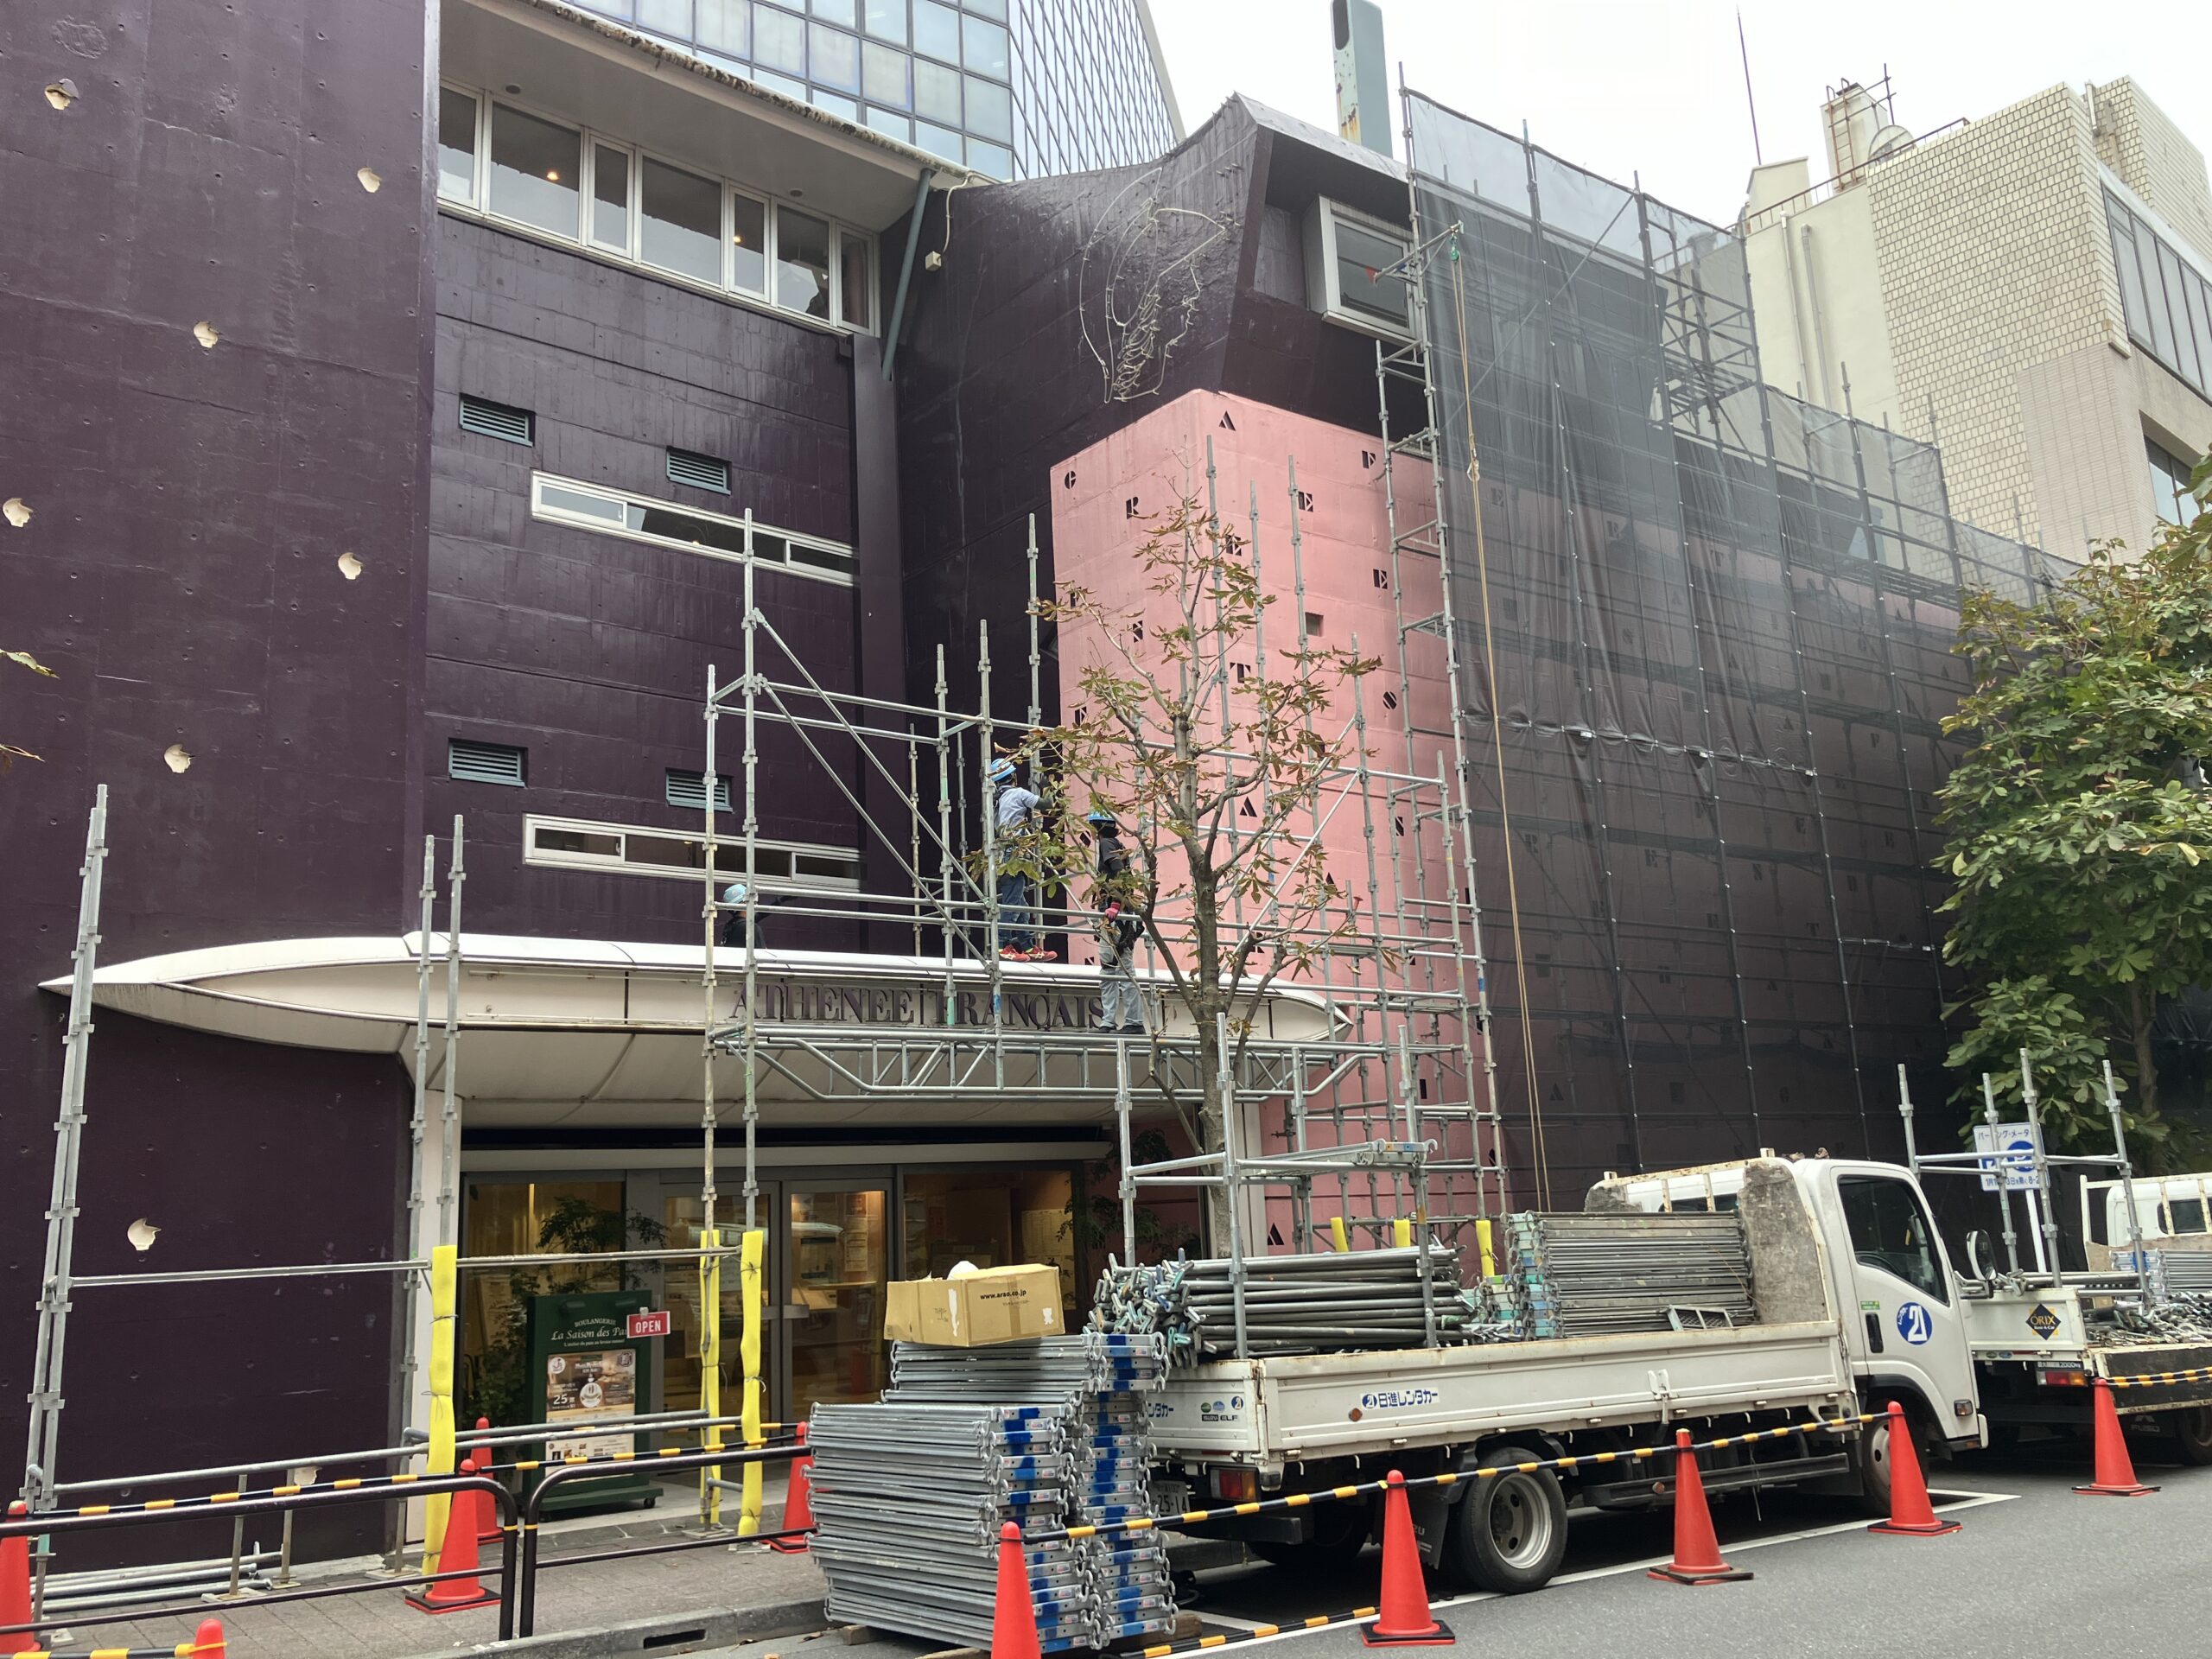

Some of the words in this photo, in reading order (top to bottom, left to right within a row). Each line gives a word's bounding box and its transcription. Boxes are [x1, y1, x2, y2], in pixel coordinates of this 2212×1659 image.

[635, 1320, 661, 1334] OPEN
[2030, 1315, 2056, 1325] ORIX
[566, 1330, 594, 1339] Saison
[596, 1325, 610, 1338] des
[1378, 1389, 1438, 1408] 日進レンタカー
[1147, 1402, 1174, 1418] ンタカー
